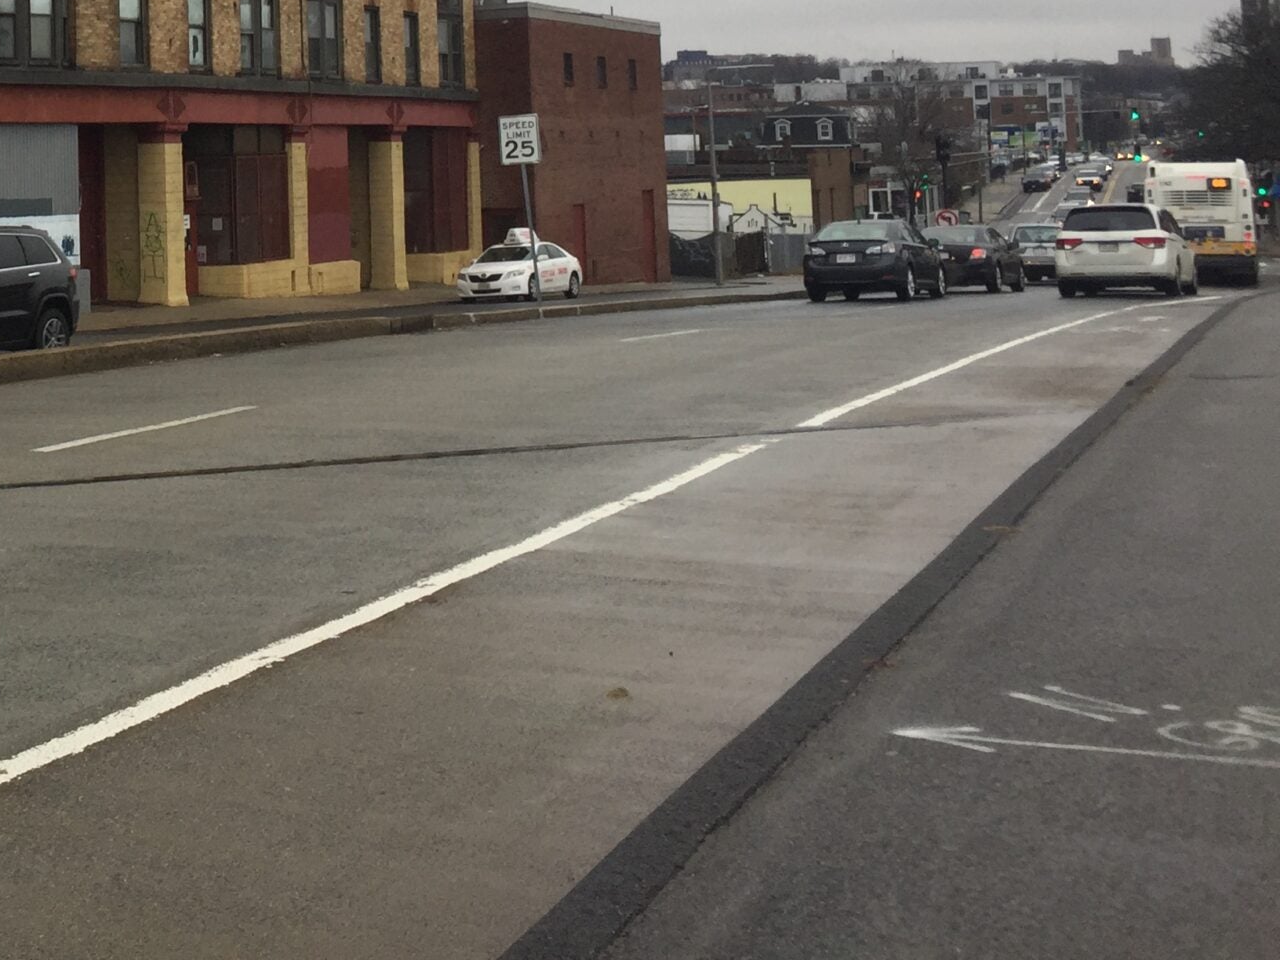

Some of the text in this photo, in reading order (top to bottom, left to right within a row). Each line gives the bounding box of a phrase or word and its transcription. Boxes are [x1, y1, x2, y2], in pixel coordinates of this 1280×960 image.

[502, 120, 535, 130] SPEED
[506, 130, 531, 139] LIMIT
[505, 140, 535, 159] 25
